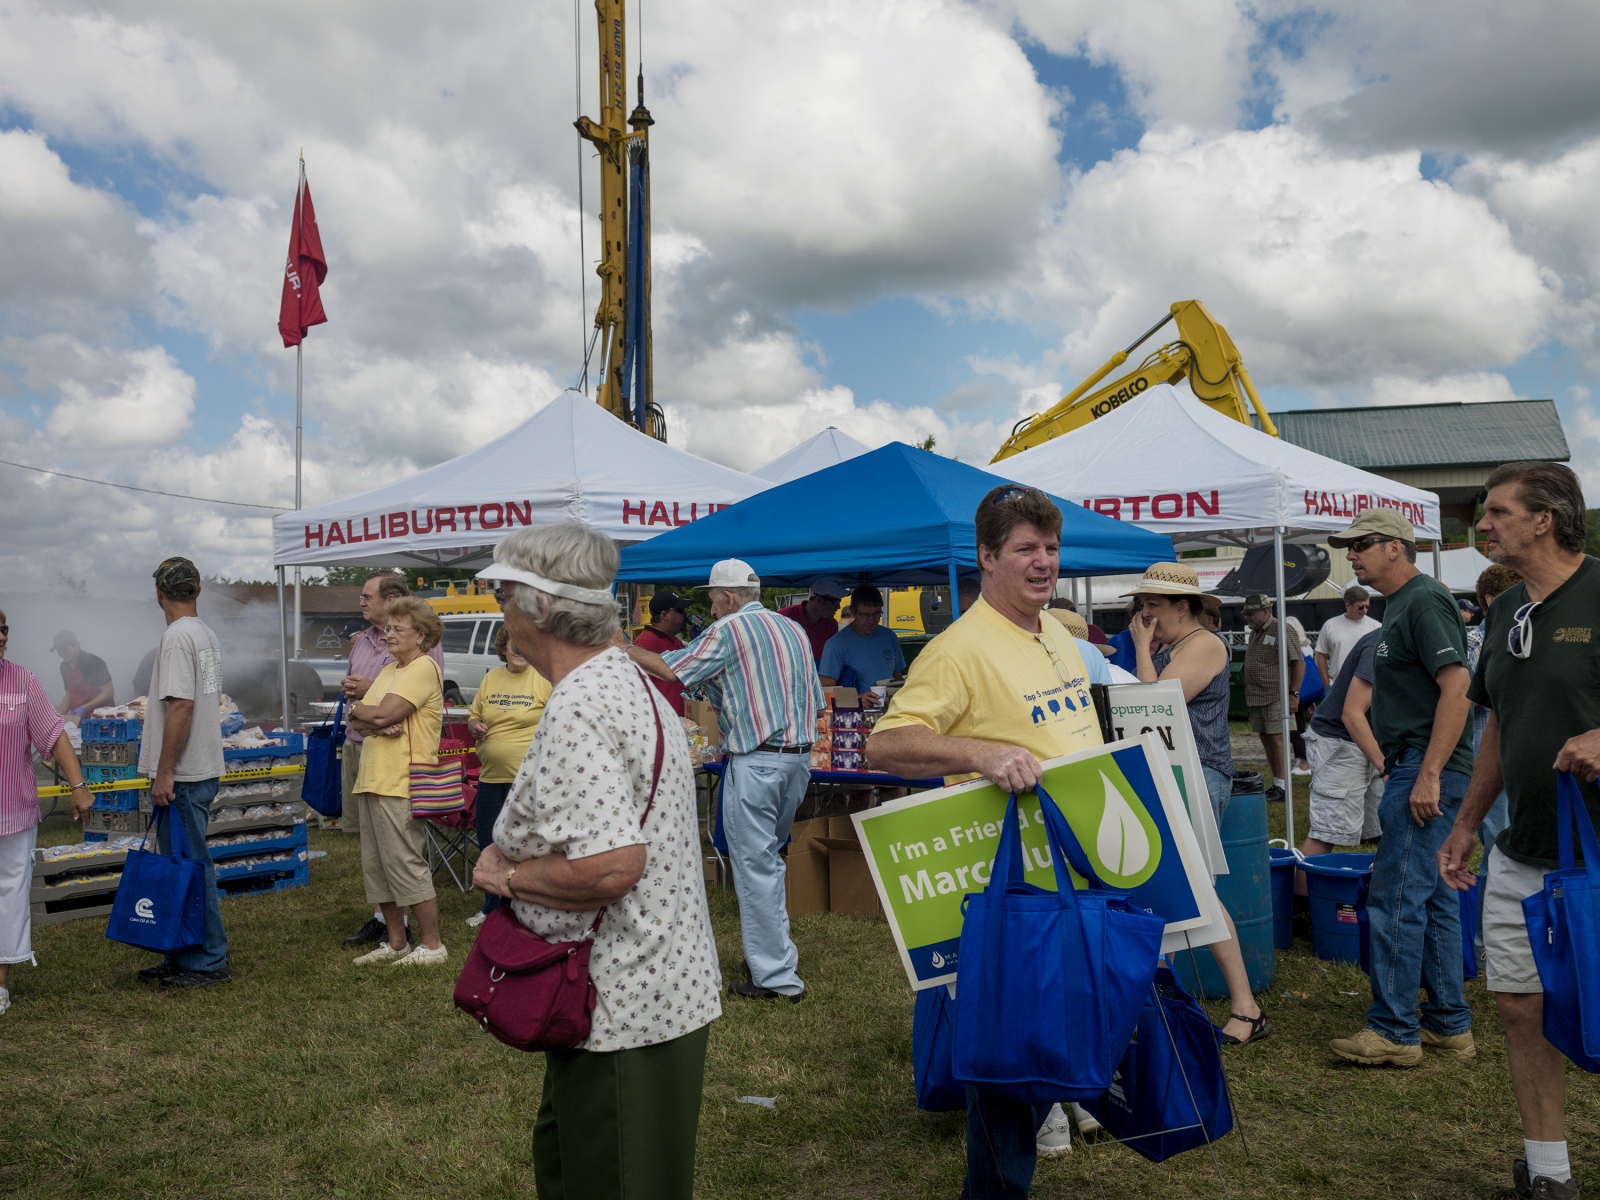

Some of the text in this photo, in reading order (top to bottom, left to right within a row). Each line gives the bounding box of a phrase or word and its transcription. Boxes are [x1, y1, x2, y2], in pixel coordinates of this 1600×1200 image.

[614, 60, 621, 80] BG
[614, 80, 622, 98] 24
[615, 98, 622, 110] H
[1090, 376, 1149, 420] KOBELCO
[304, 499, 532, 549] HALLIBURTON
[622, 499, 733, 527] HALL
[1023, 694, 1037, 702] Top
[1036, 690, 1042, 698] 5
[1110, 704, 1174, 718] Per Lando
[888, 842, 928, 864] I'm
[932, 836, 948, 852] a
[898, 840, 1069, 905] Marclu
